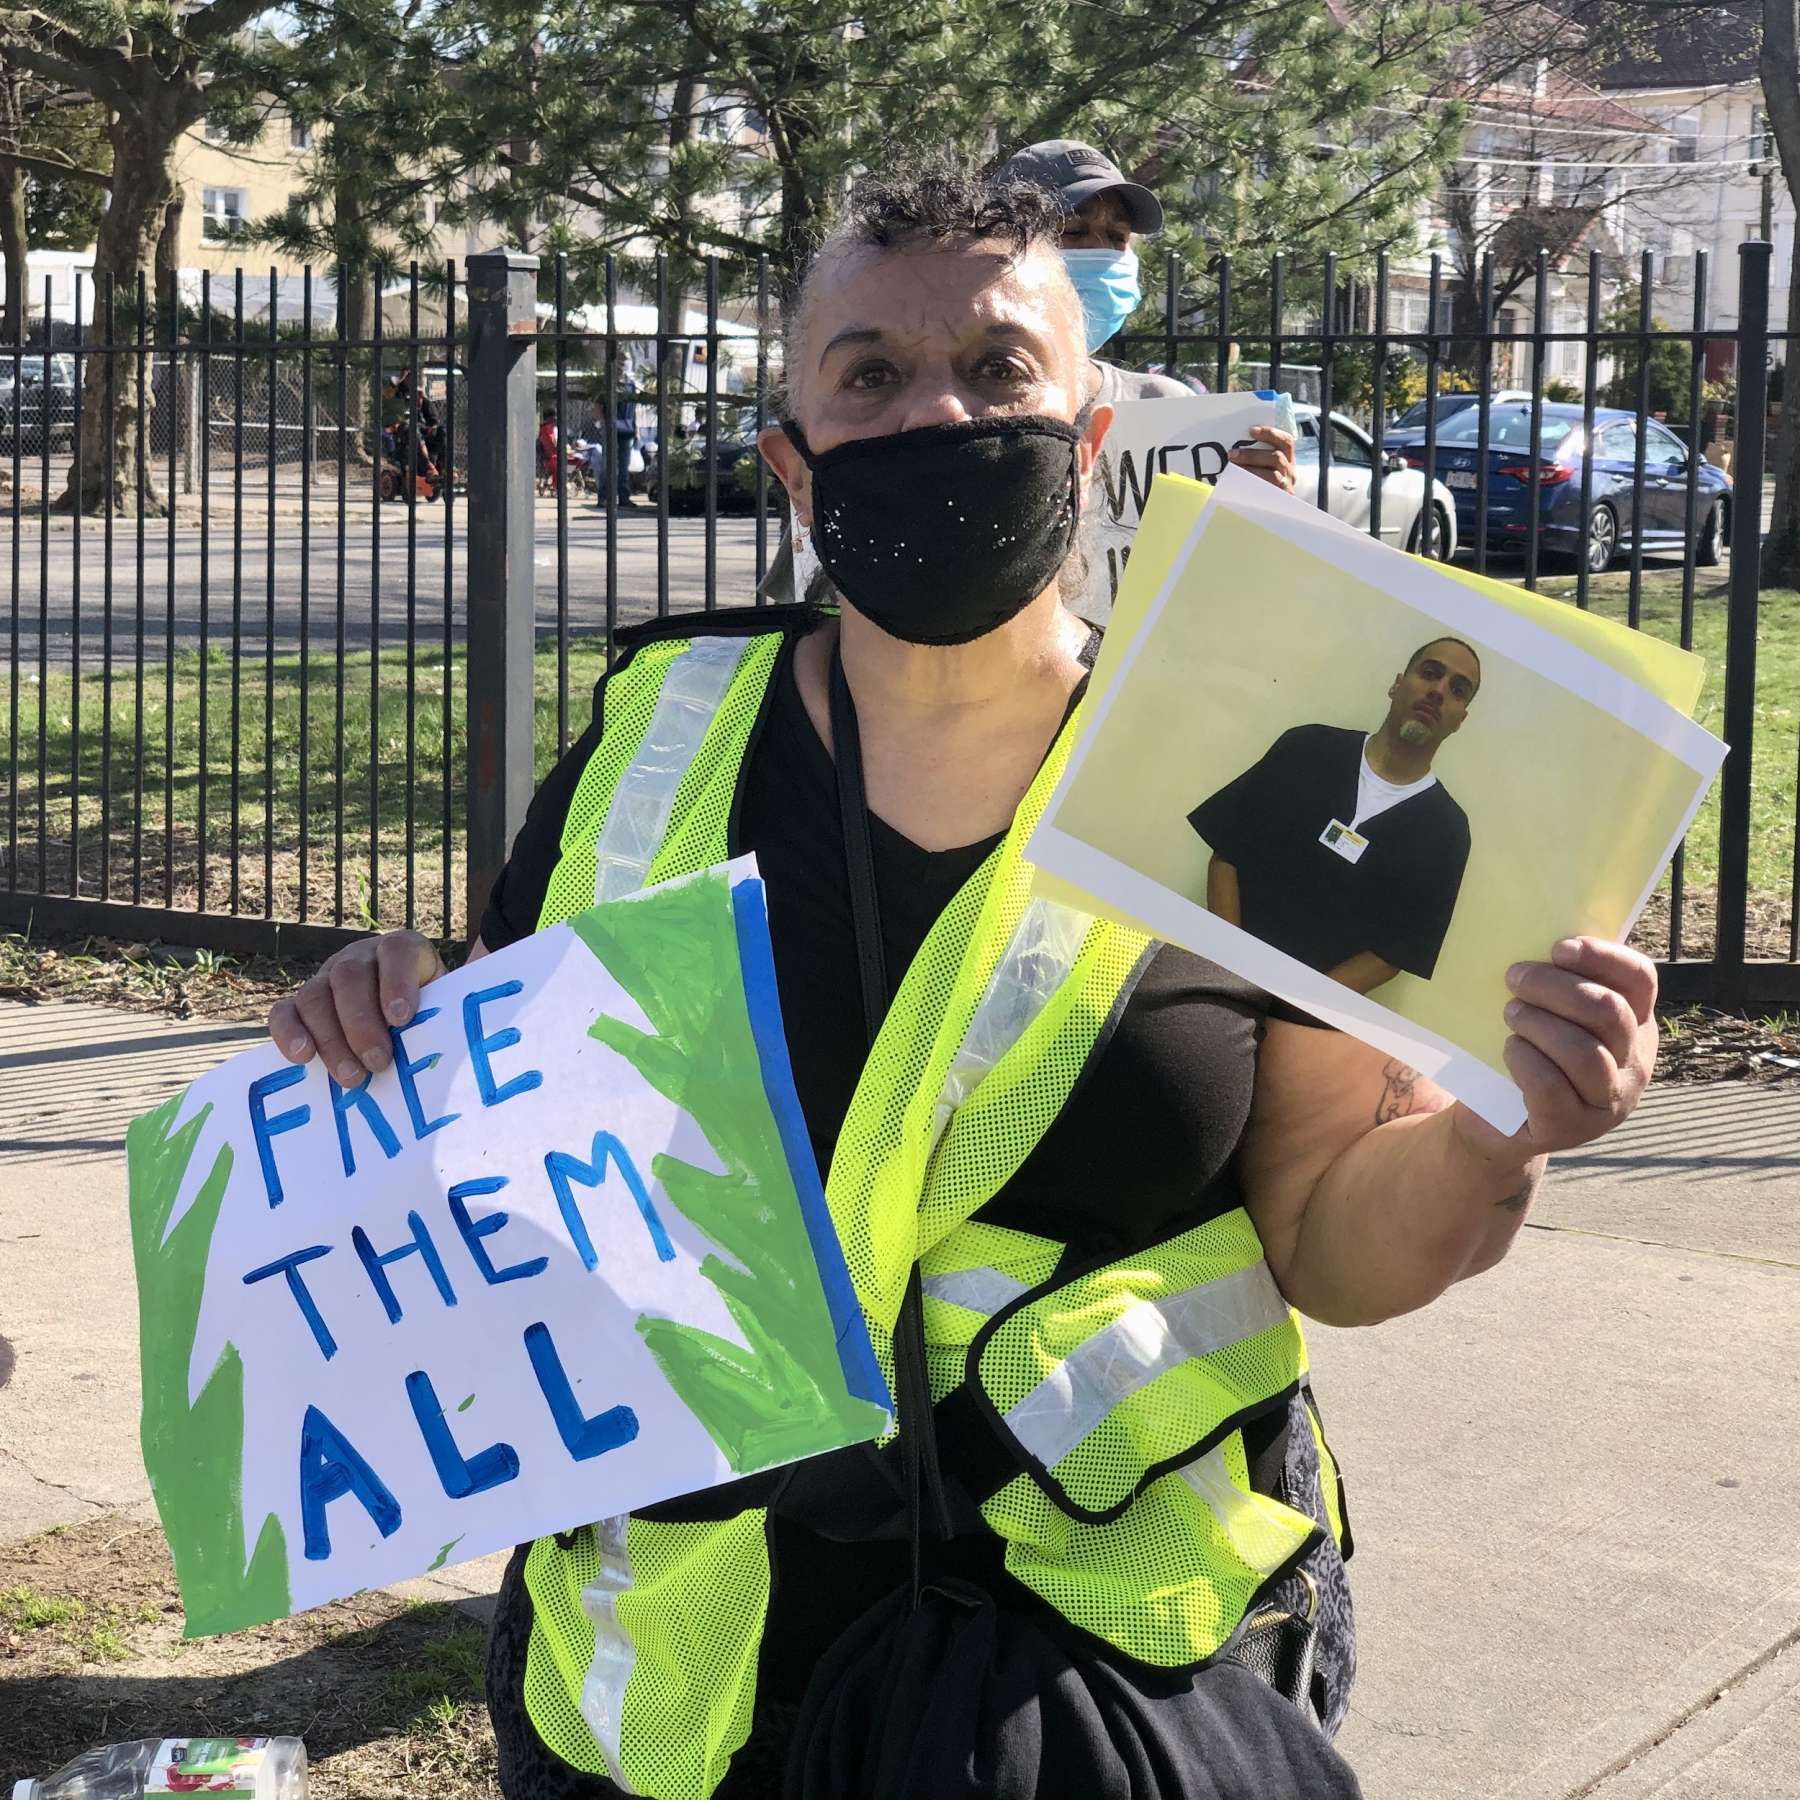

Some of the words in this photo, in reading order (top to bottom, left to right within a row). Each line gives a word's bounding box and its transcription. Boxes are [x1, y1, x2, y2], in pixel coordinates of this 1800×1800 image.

[1098, 440, 1258, 521] WR
[249, 980, 543, 1209] FREE
[243, 1131, 675, 1361] THEM
[300, 1321, 640, 1560] ALL
